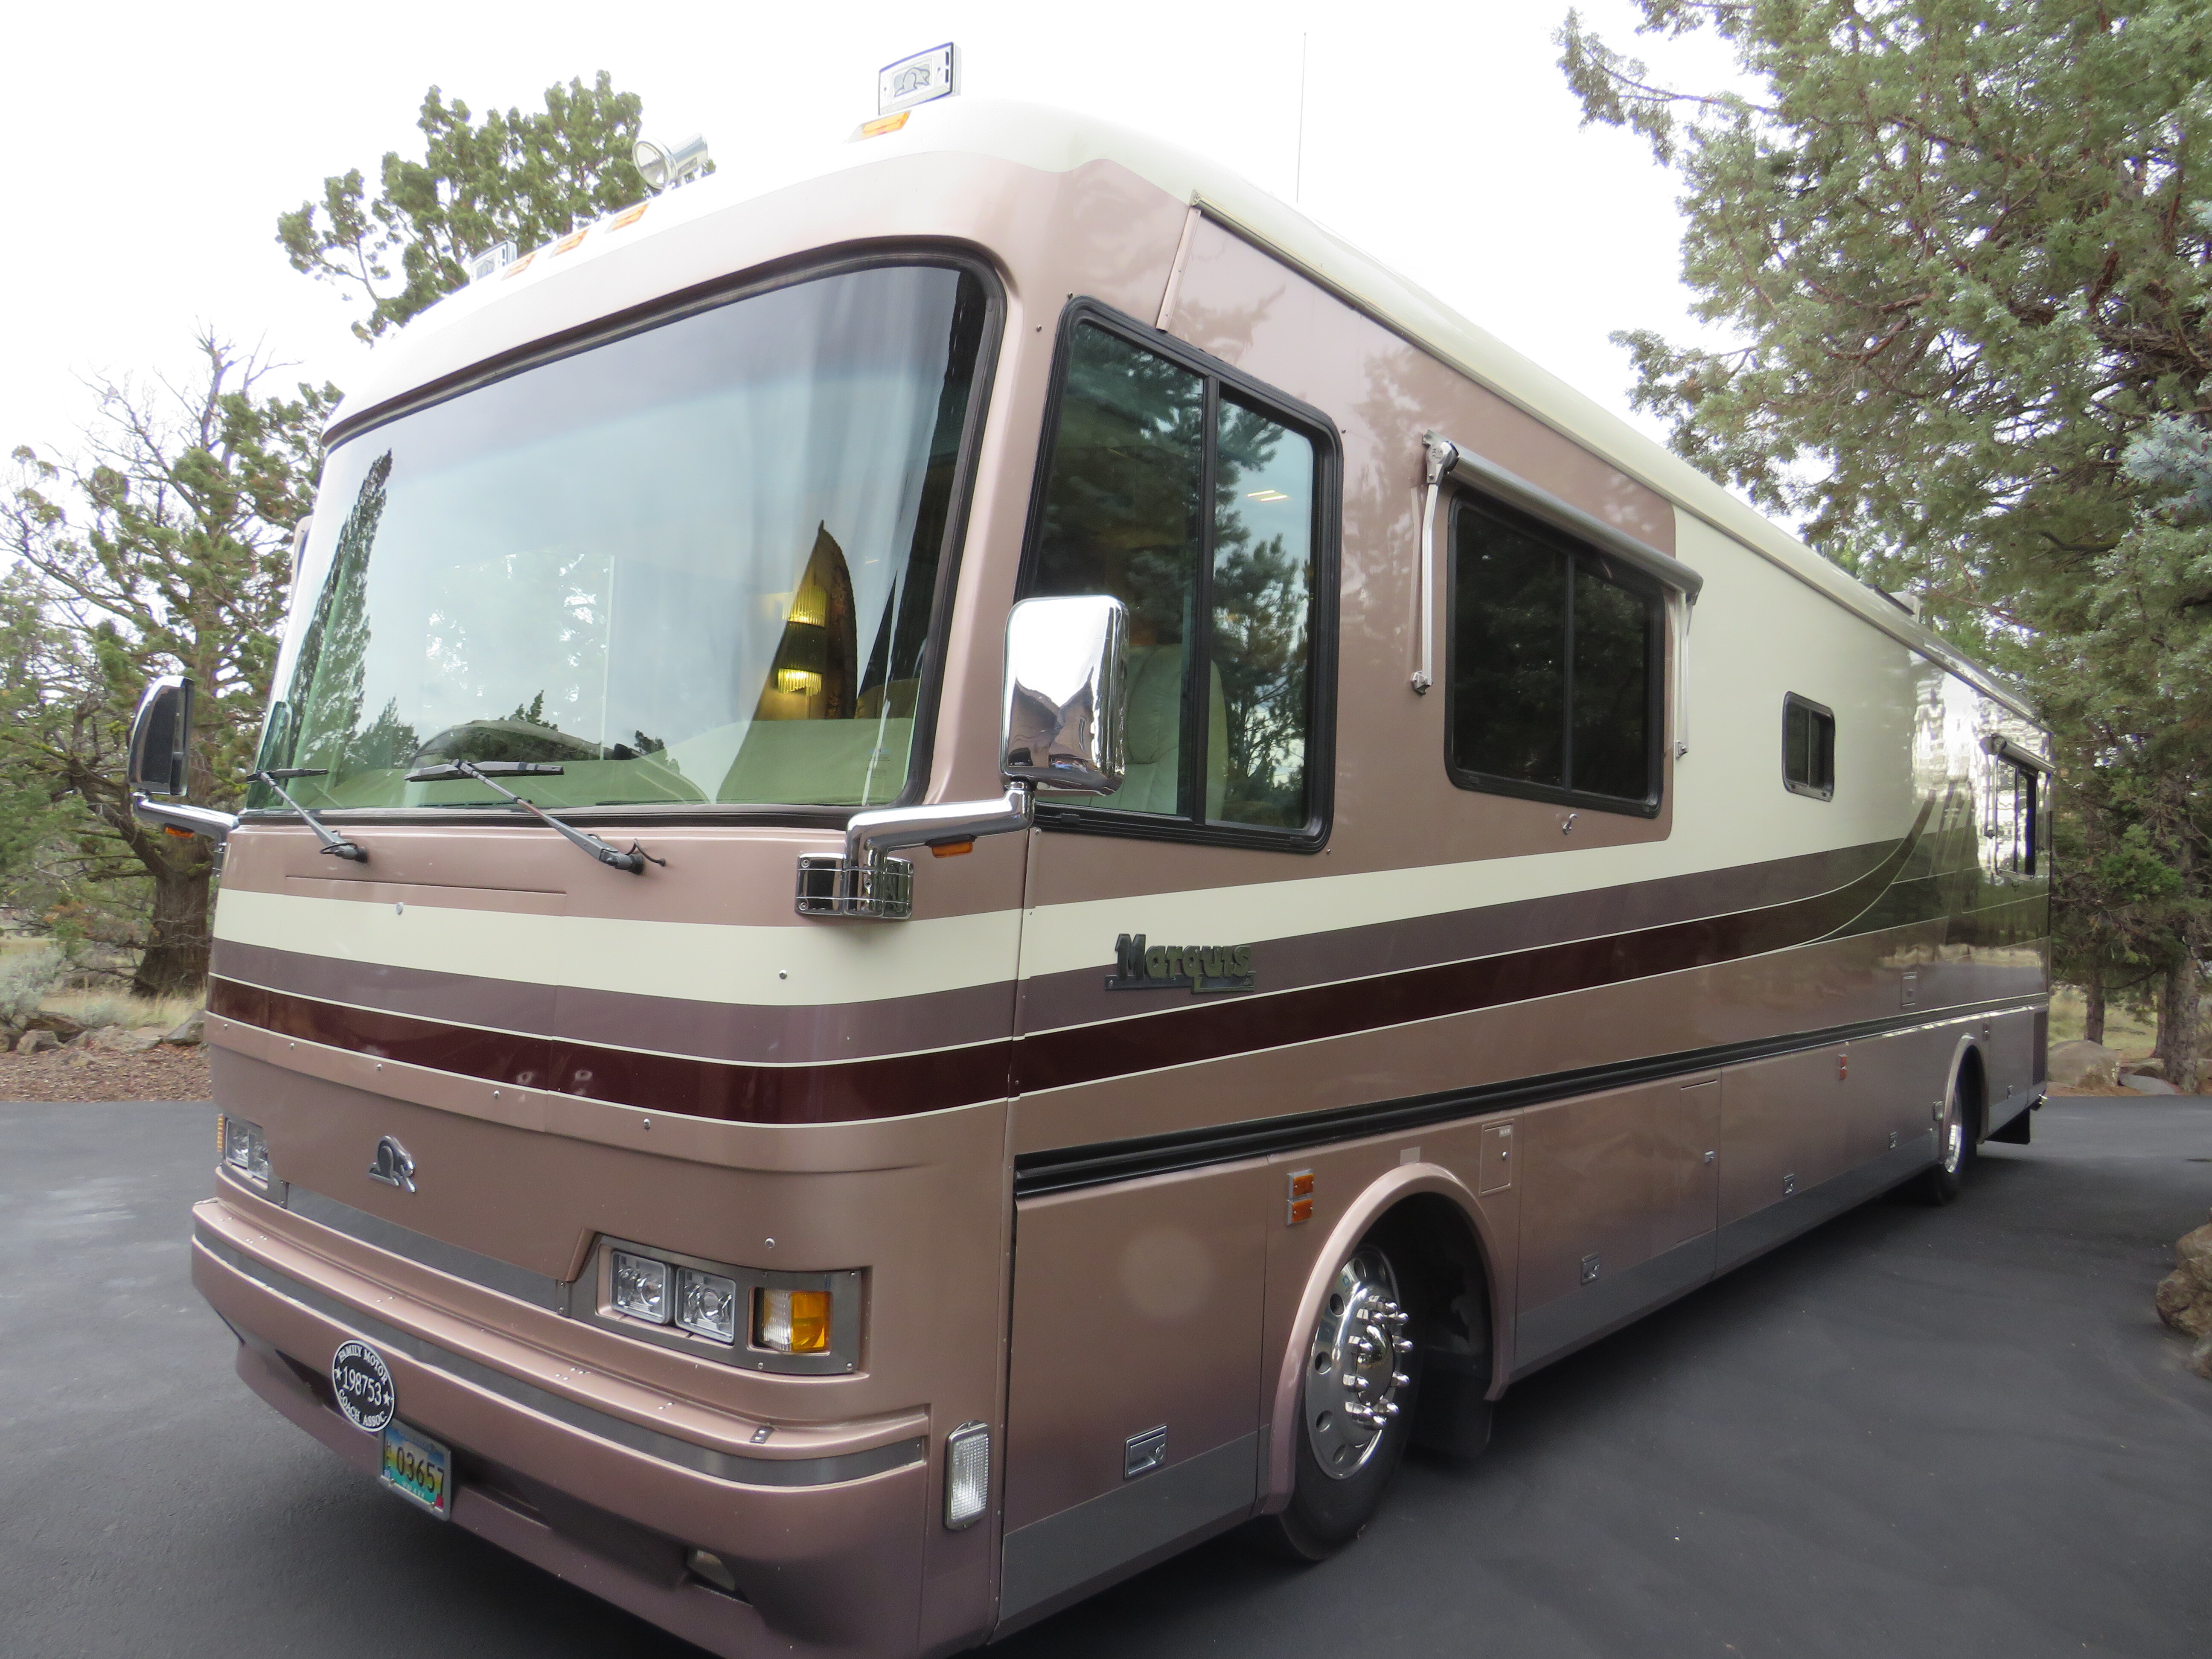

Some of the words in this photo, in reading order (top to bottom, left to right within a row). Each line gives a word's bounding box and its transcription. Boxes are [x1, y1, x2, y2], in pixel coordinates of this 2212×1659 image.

[1115, 933, 1251, 992] Marquis
[338, 1345, 362, 1363] FAMILY
[364, 1349, 388, 1385] MOTOR
[343, 1365, 382, 1406] 198753
[339, 1389, 361, 1422] COACH
[397, 1446, 444, 1496] 03657
